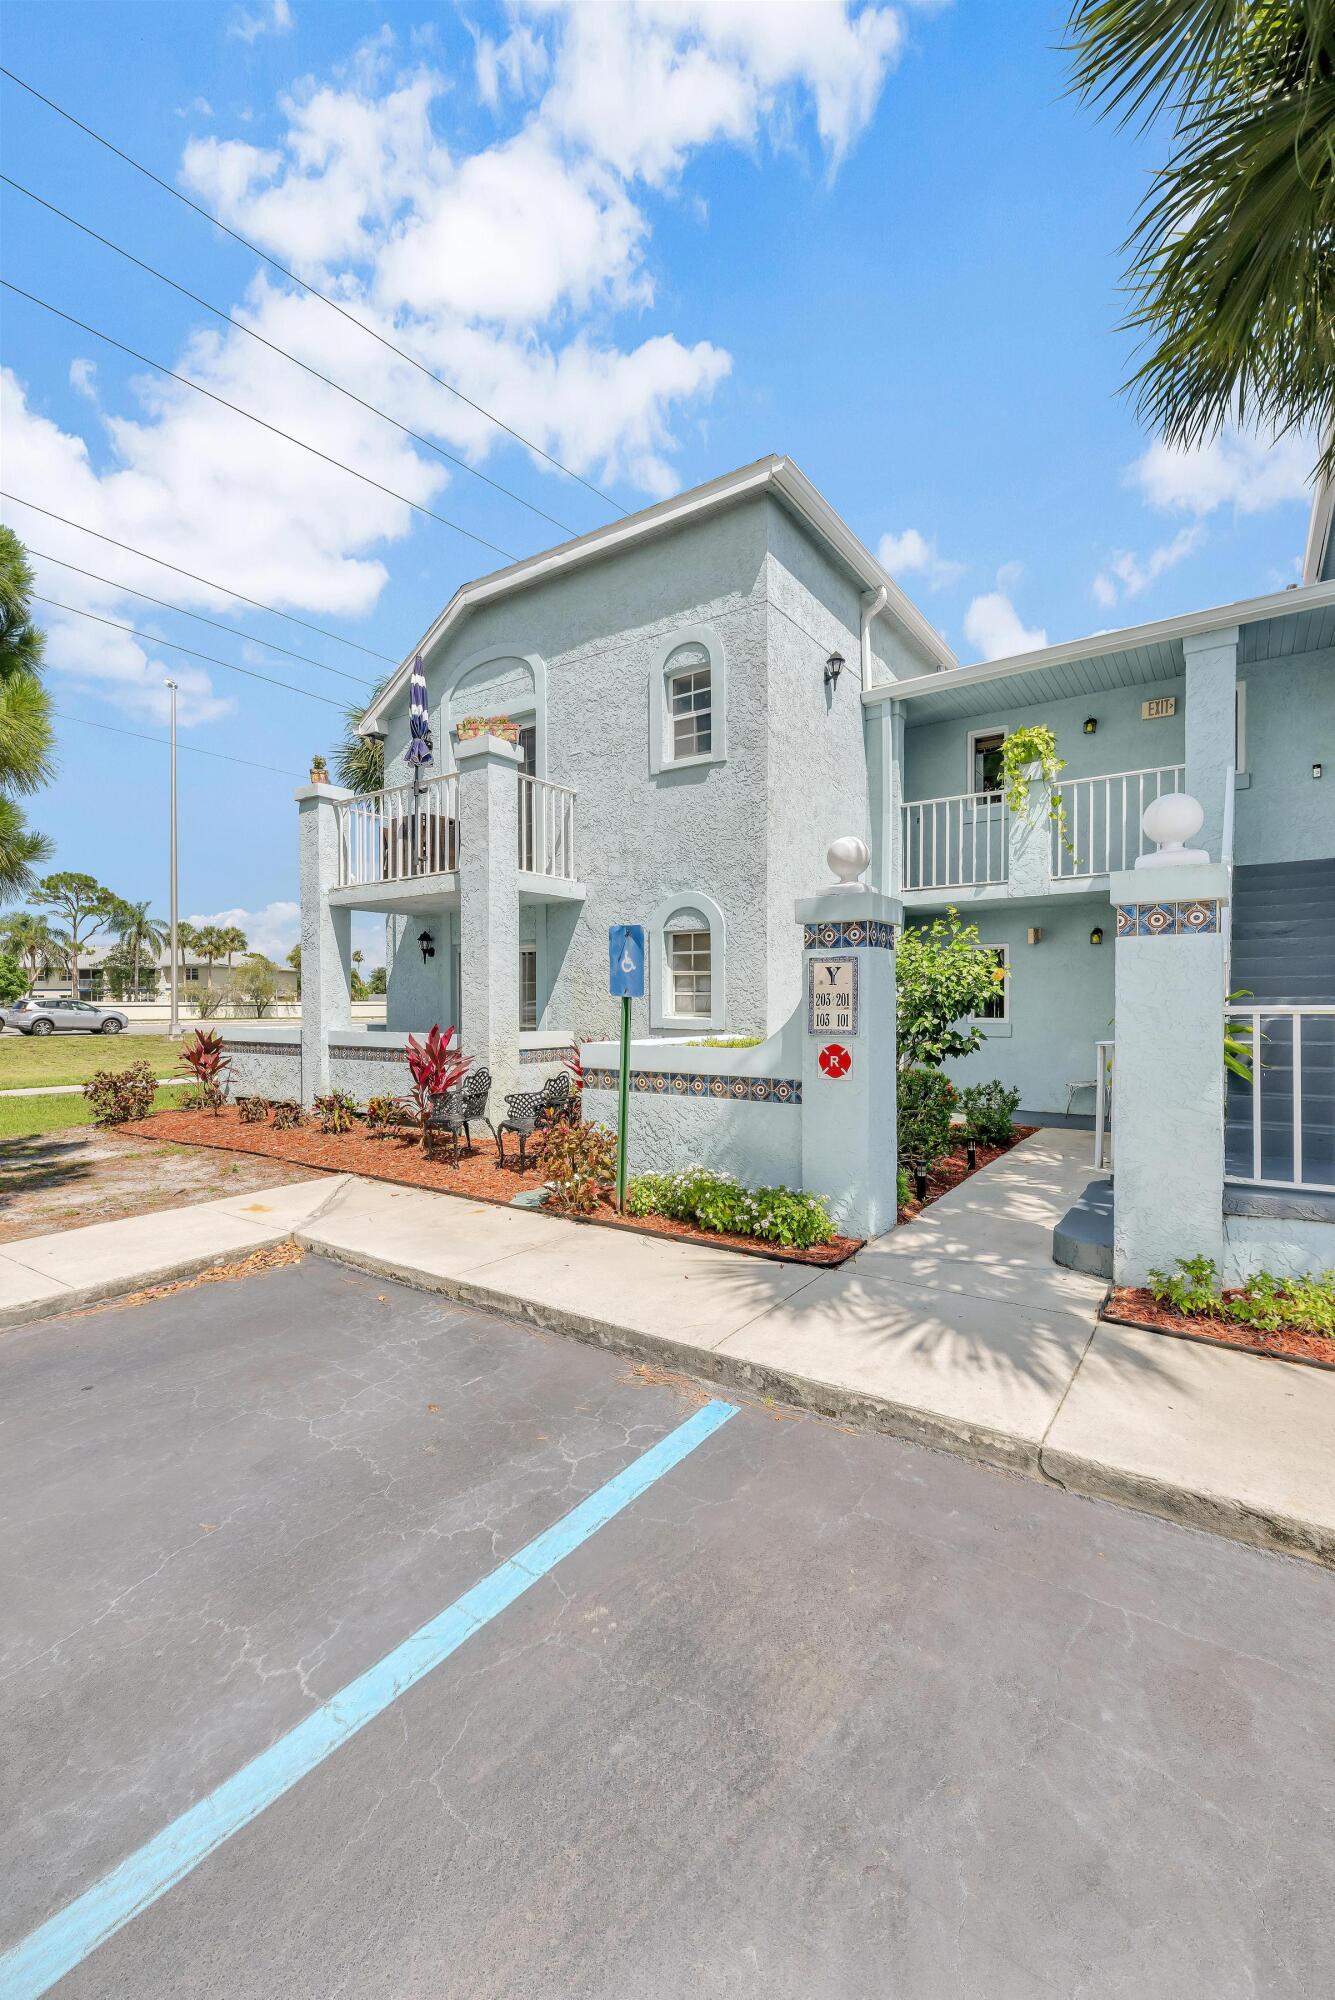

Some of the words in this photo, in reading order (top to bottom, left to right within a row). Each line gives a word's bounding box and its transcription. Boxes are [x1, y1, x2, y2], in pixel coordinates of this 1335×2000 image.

[1149, 699, 1169, 716] EXIT
[825, 967, 842, 985] Y
[815, 993, 831, 1007] 203
[836, 993, 850, 1007] 201
[816, 1013, 830, 1027] 103
[837, 1014, 849, 1027] 101
[830, 1056, 839, 1068] R
